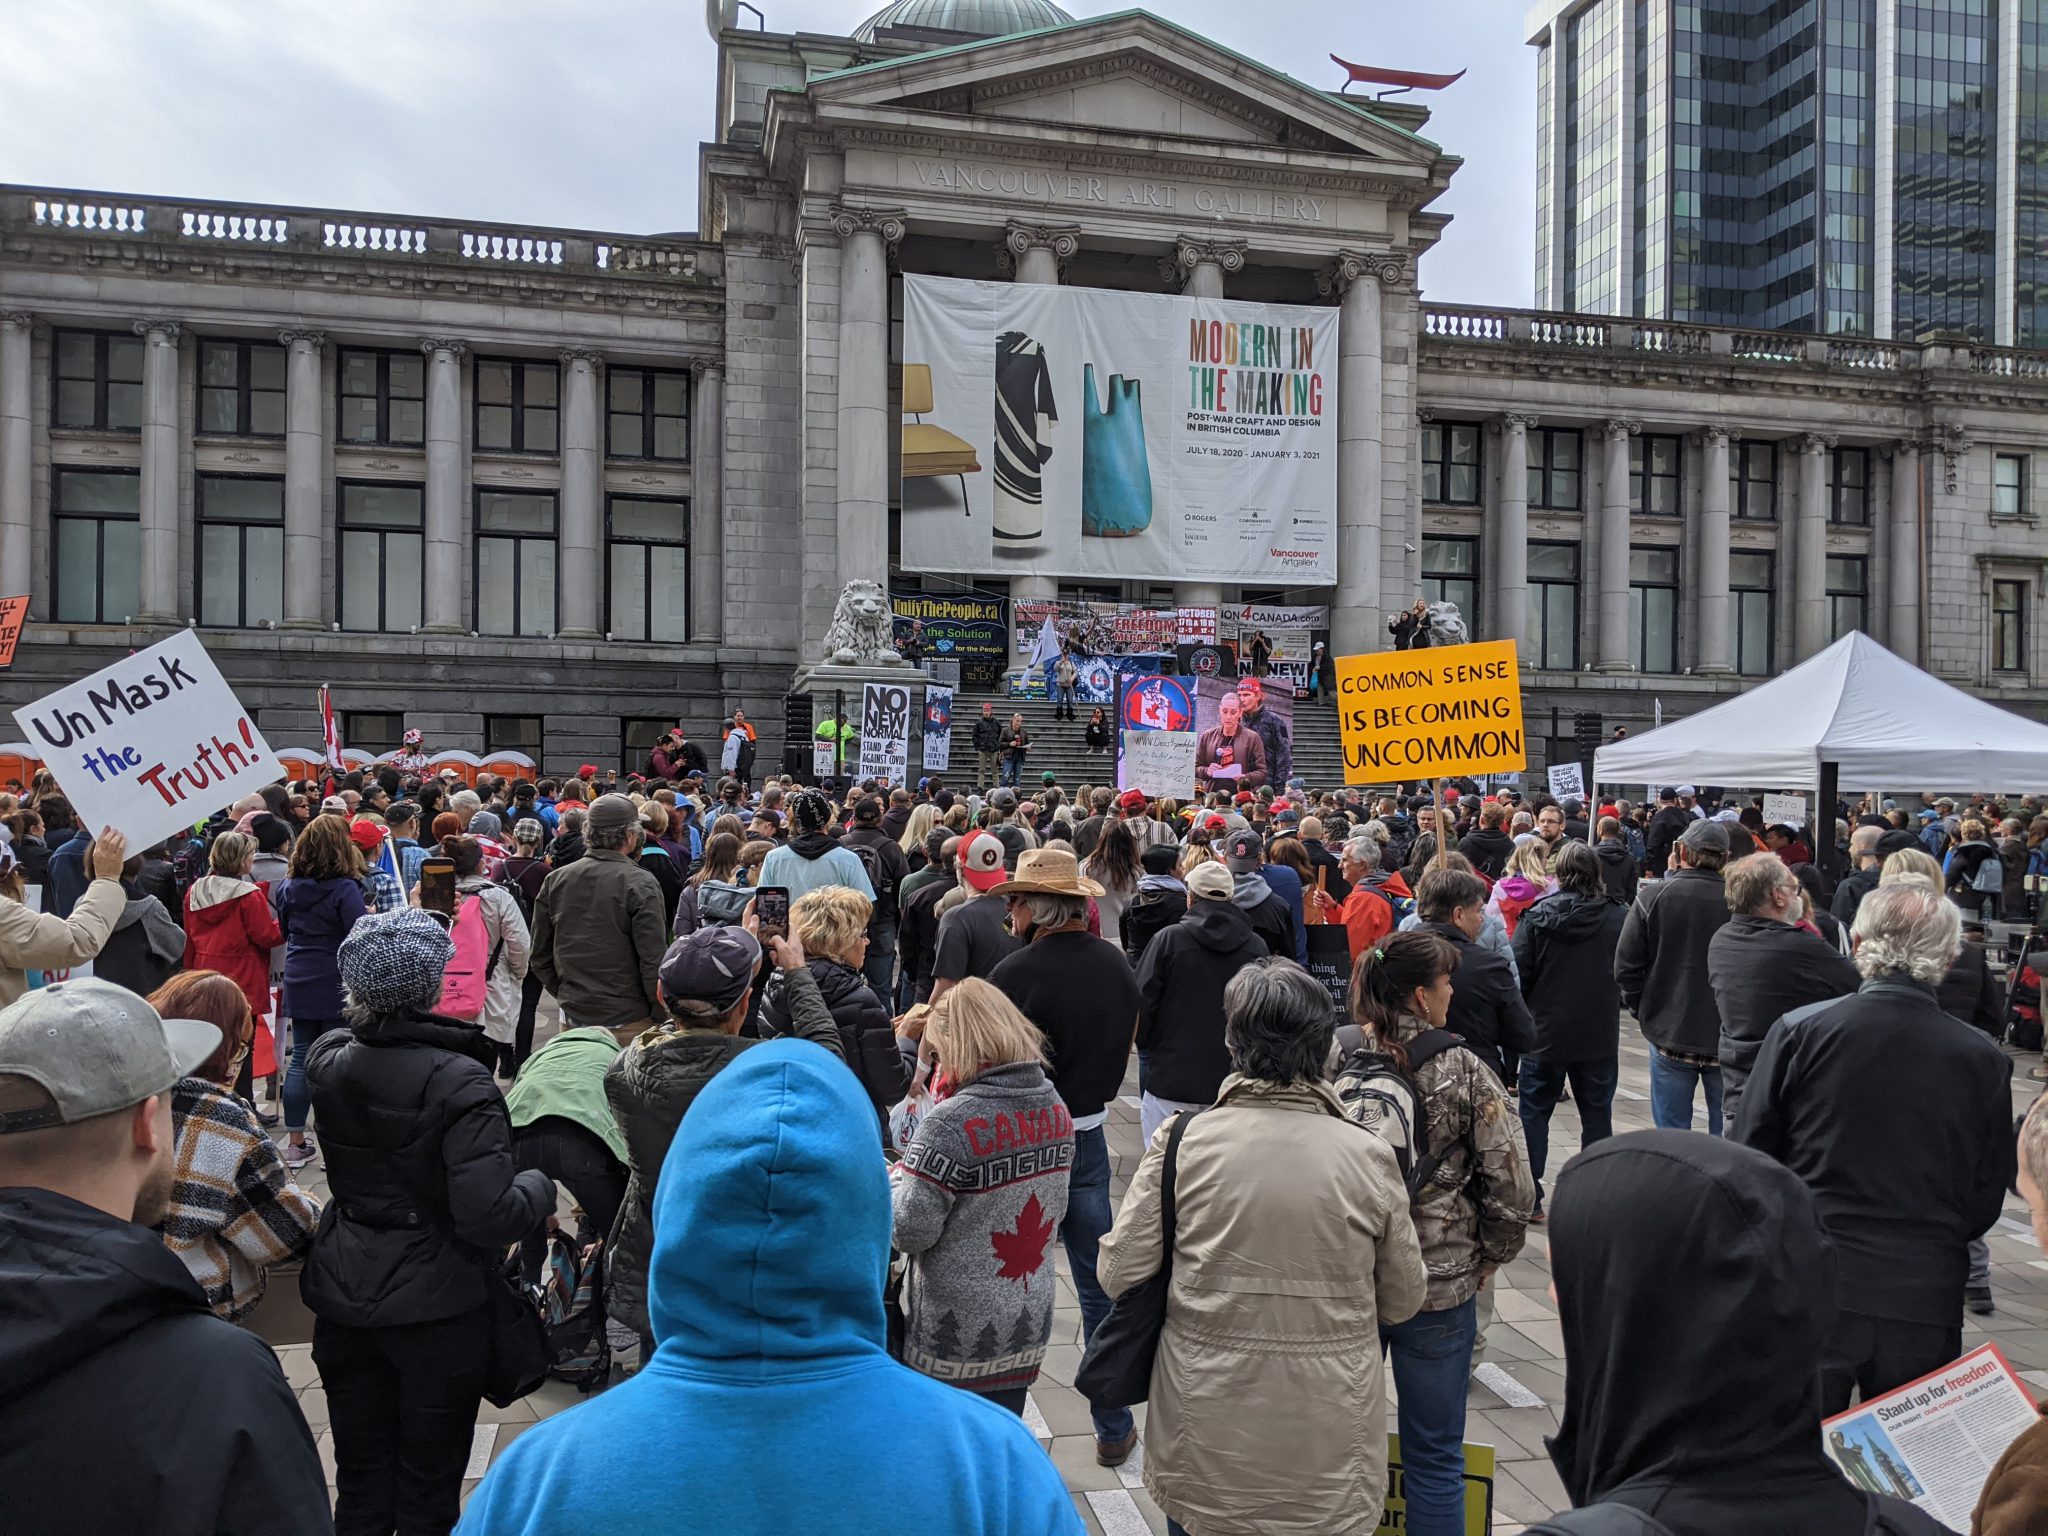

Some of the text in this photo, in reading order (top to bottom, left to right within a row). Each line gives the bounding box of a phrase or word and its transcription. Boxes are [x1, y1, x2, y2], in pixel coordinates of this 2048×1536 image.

[913, 160, 1326, 222] VANCOUVER ART GALLERY
[1190, 318, 1313, 370] MODERN IN
[1189, 366, 1322, 416] THE MAKING
[1187, 412, 1234, 424] POST-WAR
[1235, 417, 1264, 426] CRAFT
[1288, 418, 1321, 427] DESIGN
[1187, 423, 1281, 436] IN BRITISH COLUMBIA
[1186, 446, 1208, 455] JULY
[1210, 448, 1220, 456] 18,
[1222, 448, 1243, 457] 2020
[1250, 450, 1291, 459] JANUARY
[1303, 451, 1320, 459] 2021
[1270, 548, 1319, 558] Vancouver
[1281, 557, 1319, 568] Artgallery
[893, 598, 998, 620] UnifyThePeople.ca
[1178, 608, 1215, 618] OCTOBER
[1115, 618, 1175, 632] FREEDOM
[927, 627, 992, 639] the Solution
[980, 646, 1004, 654] People
[1200, 656, 1211, 671] Q
[1268, 662, 1305, 676] NEW
[1341, 660, 1510, 694] COMMON SENSE
[865, 685, 907, 713] NO
[864, 710, 907, 731] NEW
[1344, 696, 1511, 731] IS BECOMING
[864, 727, 905, 740] NORMAL
[862, 741, 882, 753] STAND
[1342, 728, 1521, 769] UNCOMMON
[82, 746, 142, 783] the
[136, 716, 260, 808] Truth!
[862, 753, 906, 766] AGAINST COVID
[861, 764, 893, 777] TYRANNY!
[1236, 843, 1246, 857] B
[1311, 963, 1336, 975] thing
[1331, 976, 1347, 986] the
[1877, 1361, 1998, 1422] Stand up for freedom
[1888, 1374, 2005, 1432] OUR RIGHT OUR CHOICE OUR FUTURE
